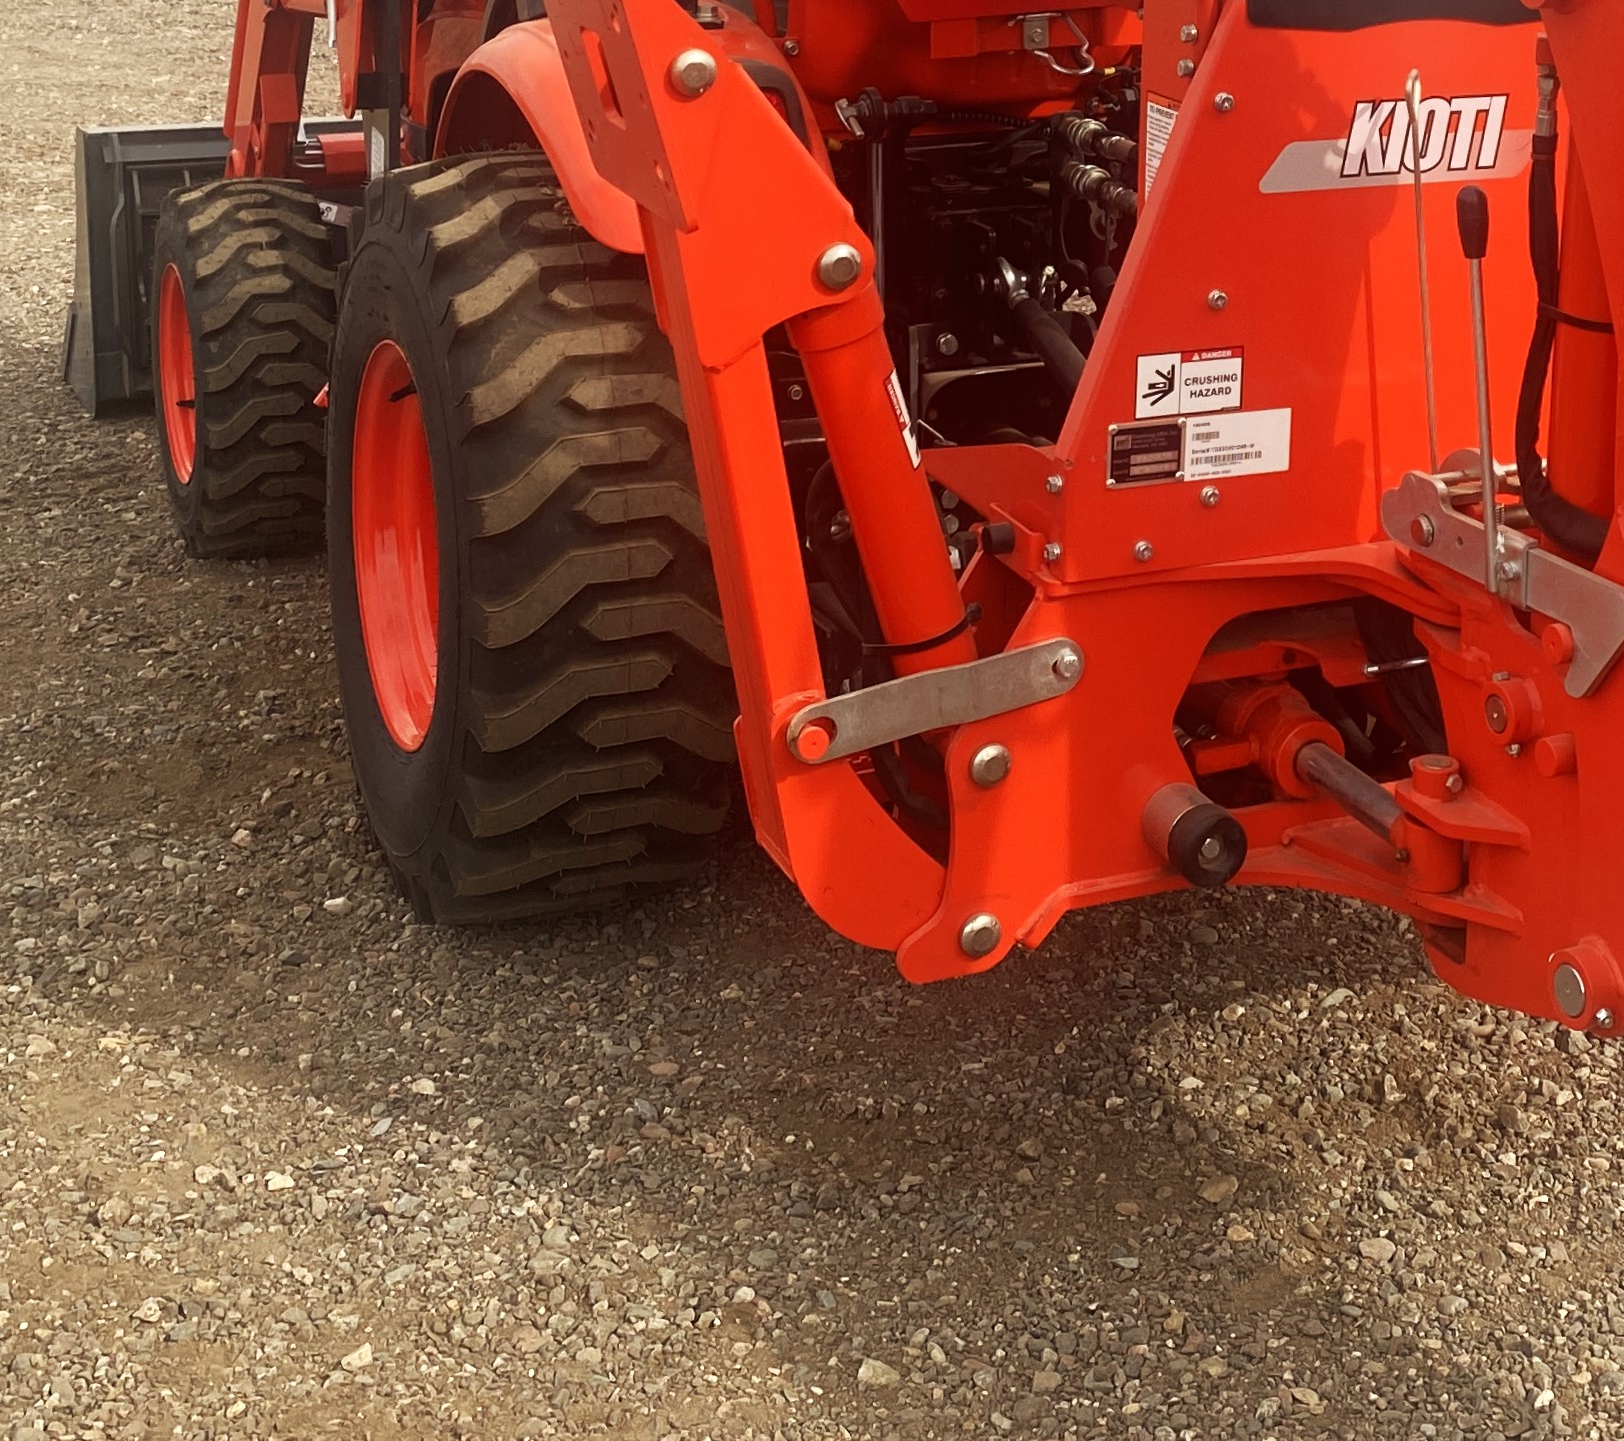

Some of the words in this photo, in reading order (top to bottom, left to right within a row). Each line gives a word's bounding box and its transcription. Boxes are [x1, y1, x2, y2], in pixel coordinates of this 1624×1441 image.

[1340, 93, 1510, 178] KIOTI
[1201, 350, 1232, 359] DANGER
[1184, 373, 1238, 387] CRUSHING
[1190, 386, 1232, 399] HAZARD
